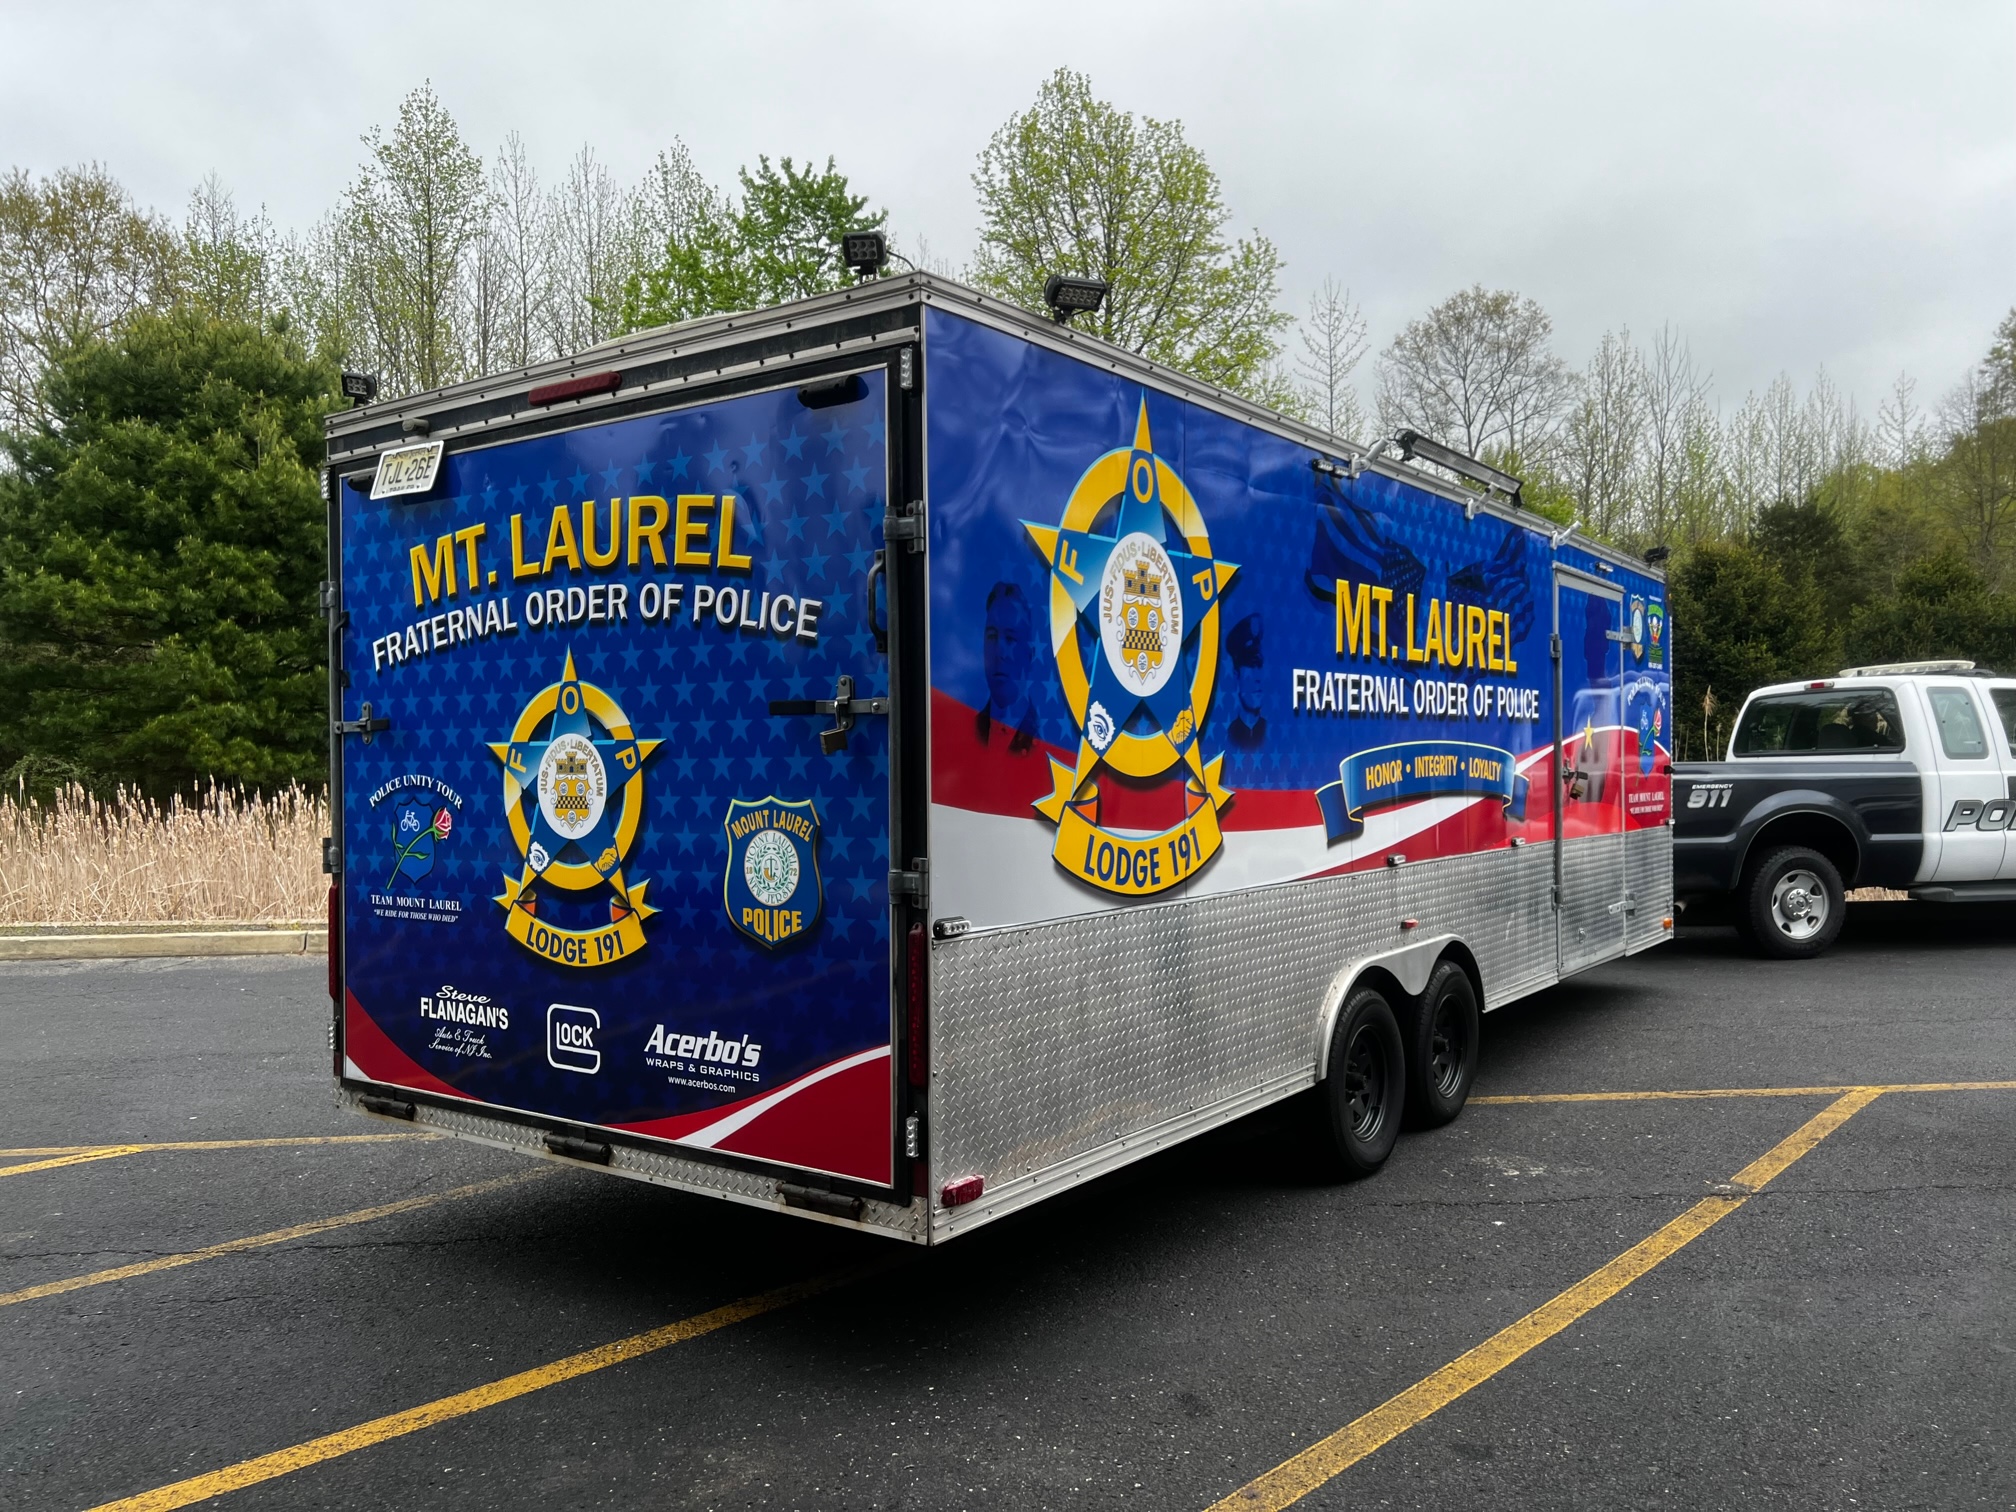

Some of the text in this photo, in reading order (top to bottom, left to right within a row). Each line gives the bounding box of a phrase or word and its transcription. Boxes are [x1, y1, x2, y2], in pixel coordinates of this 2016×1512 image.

[382, 455, 436, 486] TJL 26E
[1058, 457, 1214, 602] F O P
[408, 494, 753, 607] MT. LAUREL
[1103, 584, 1114, 624] JUS
[1109, 541, 1138, 581] FIDUS
[372, 582, 824, 673] FRATERNAL ORDER OF POLICE
[1335, 578, 1518, 672] MT. LAUREL
[1292, 668, 1540, 719] FRATERNAL ORDER OF POLICE
[509, 686, 637, 774] F O P
[540, 768, 549, 794] JUS
[545, 741, 567, 768] FIDUS
[1366, 756, 1502, 790] HONOR INTEGRITY LOYALTY
[369, 774, 463, 809] POLICE UNITY TOUR
[1687, 789, 1732, 808] 911
[731, 809, 814, 842] MOUNT LAUREL
[746, 832, 769, 864] MOUNT
[1084, 826, 1202, 888] LODGE 191
[789, 868, 798, 876] 72
[370, 894, 462, 911] TEAM MOUNT LAUREL
[747, 877, 796, 904] NEW JERSEY
[385, 909, 397, 918] RIDE
[398, 911, 409, 919] FOR
[410, 911, 427, 920] THOSE
[428, 913, 441, 922] WHO
[742, 907, 803, 943] POLICE
[525, 921, 625, 964] LODGE 191
[436, 985, 491, 1004] Steve
[420, 996, 509, 1030] FLANAGAN'S
[428, 1037, 454, 1053] Service
[454, 1043, 465, 1057] of
[434, 1026, 486, 1045] Auto & Truck
[643, 1023, 762, 1068] Acerbo's
[645, 1057, 760, 1082] WRAPS & GRAPHICS
[668, 1076, 736, 1094] www.acerbos.com
